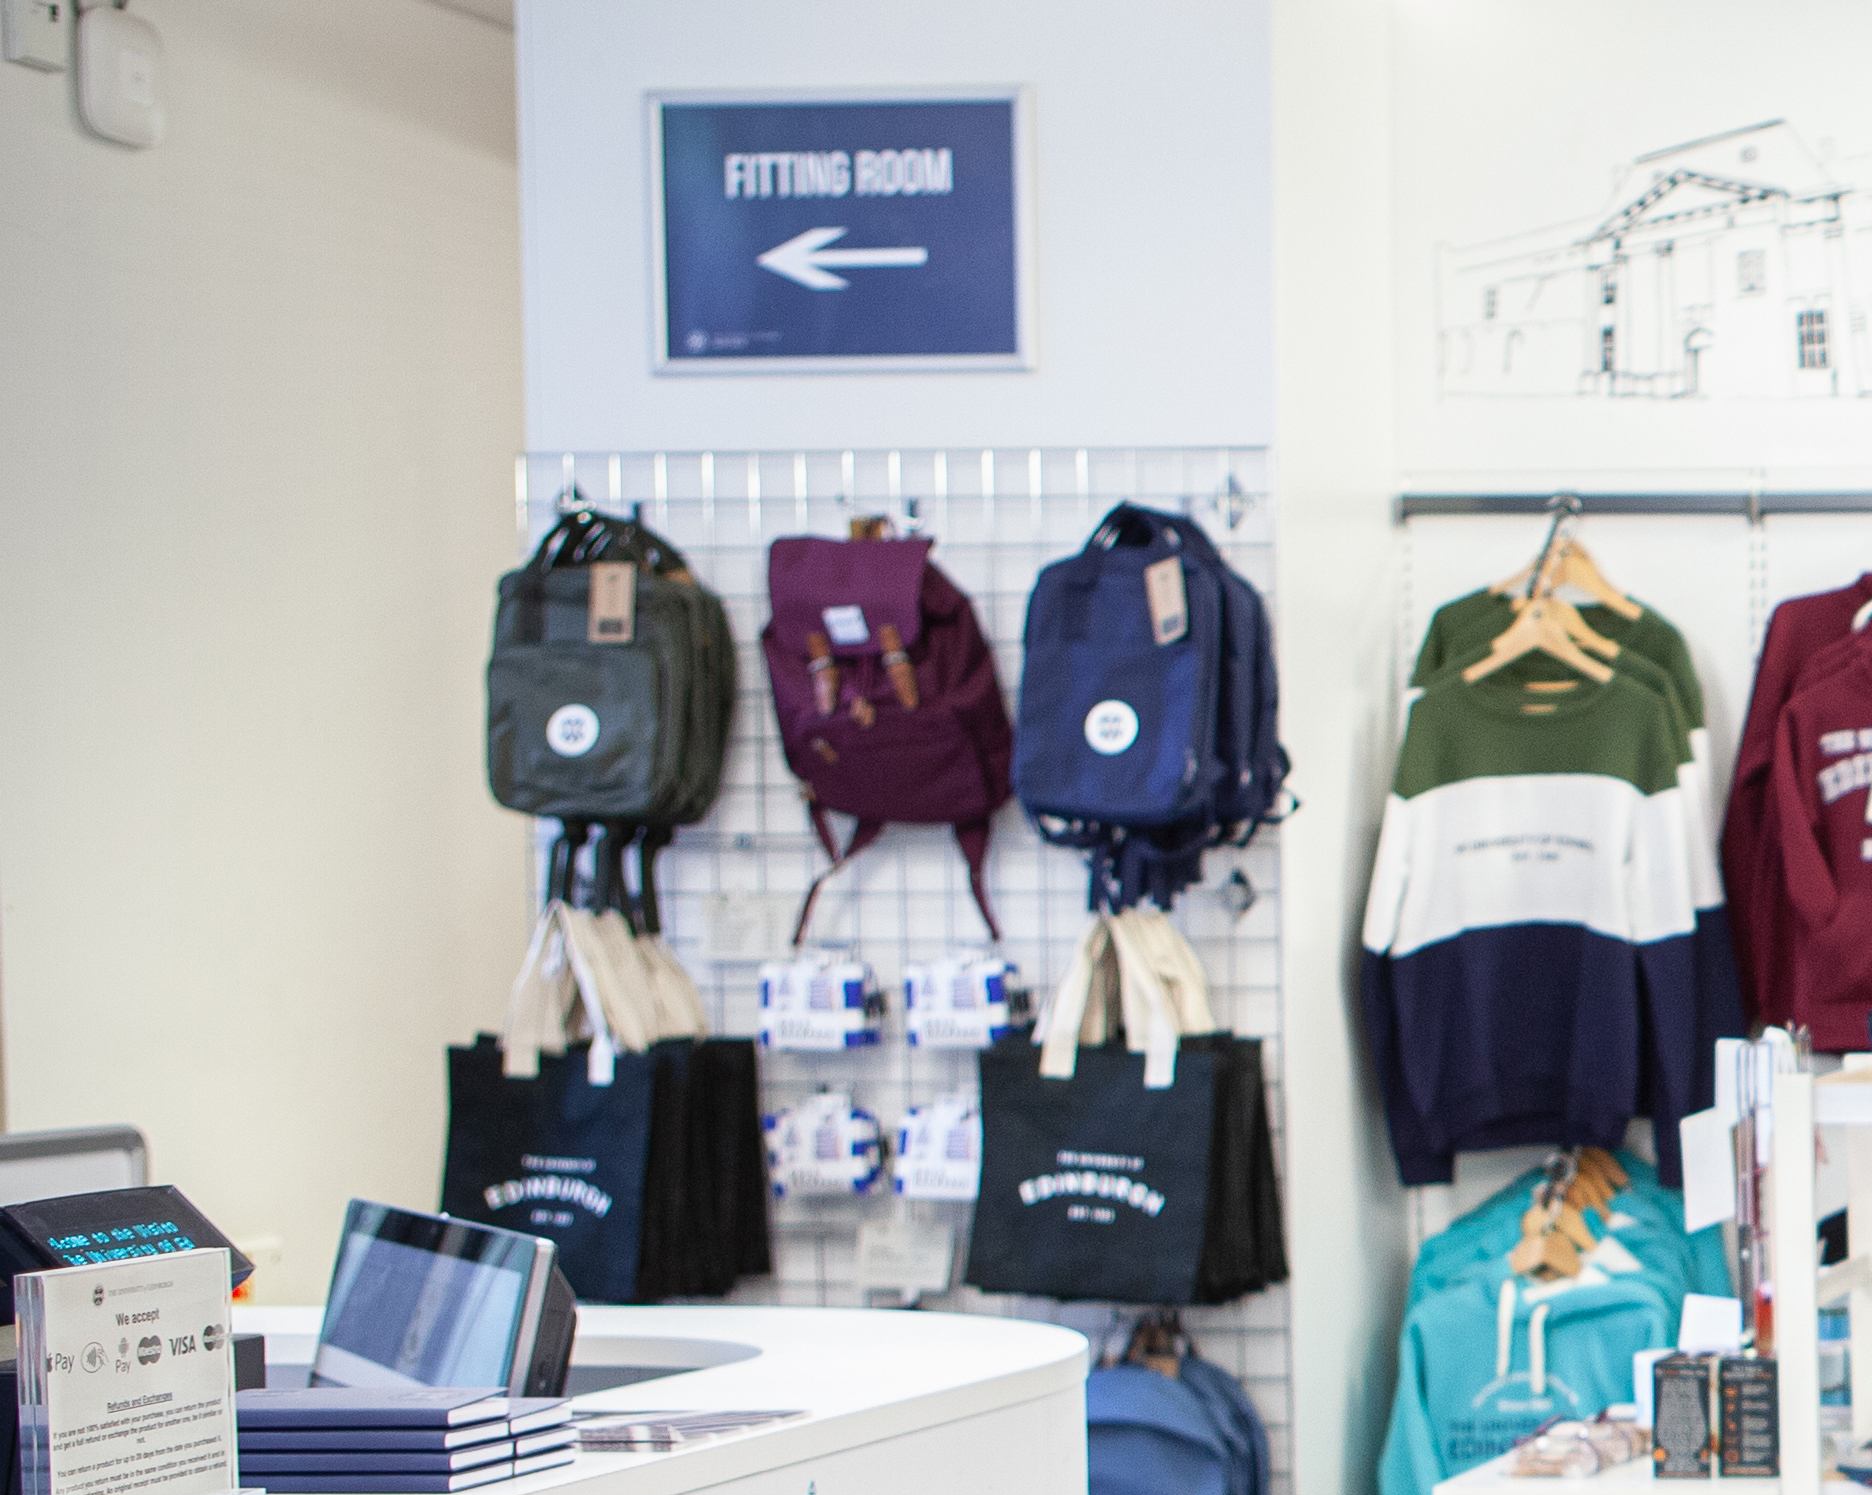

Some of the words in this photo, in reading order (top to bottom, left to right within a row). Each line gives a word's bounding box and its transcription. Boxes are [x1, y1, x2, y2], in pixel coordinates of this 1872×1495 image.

[724, 152, 850, 199] FITTING
[855, 148, 954, 195] ROOM
[483, 1175, 613, 1218] EDINBURGH
[1018, 1170, 1166, 1217] EDINBURGH
[115, 1313, 130, 1326] We
[131, 1309, 160, 1324] accept
[169, 1335, 197, 1356] VISA
[55, 1353, 74, 1374] Pay
[115, 1359, 131, 1374] Pay
